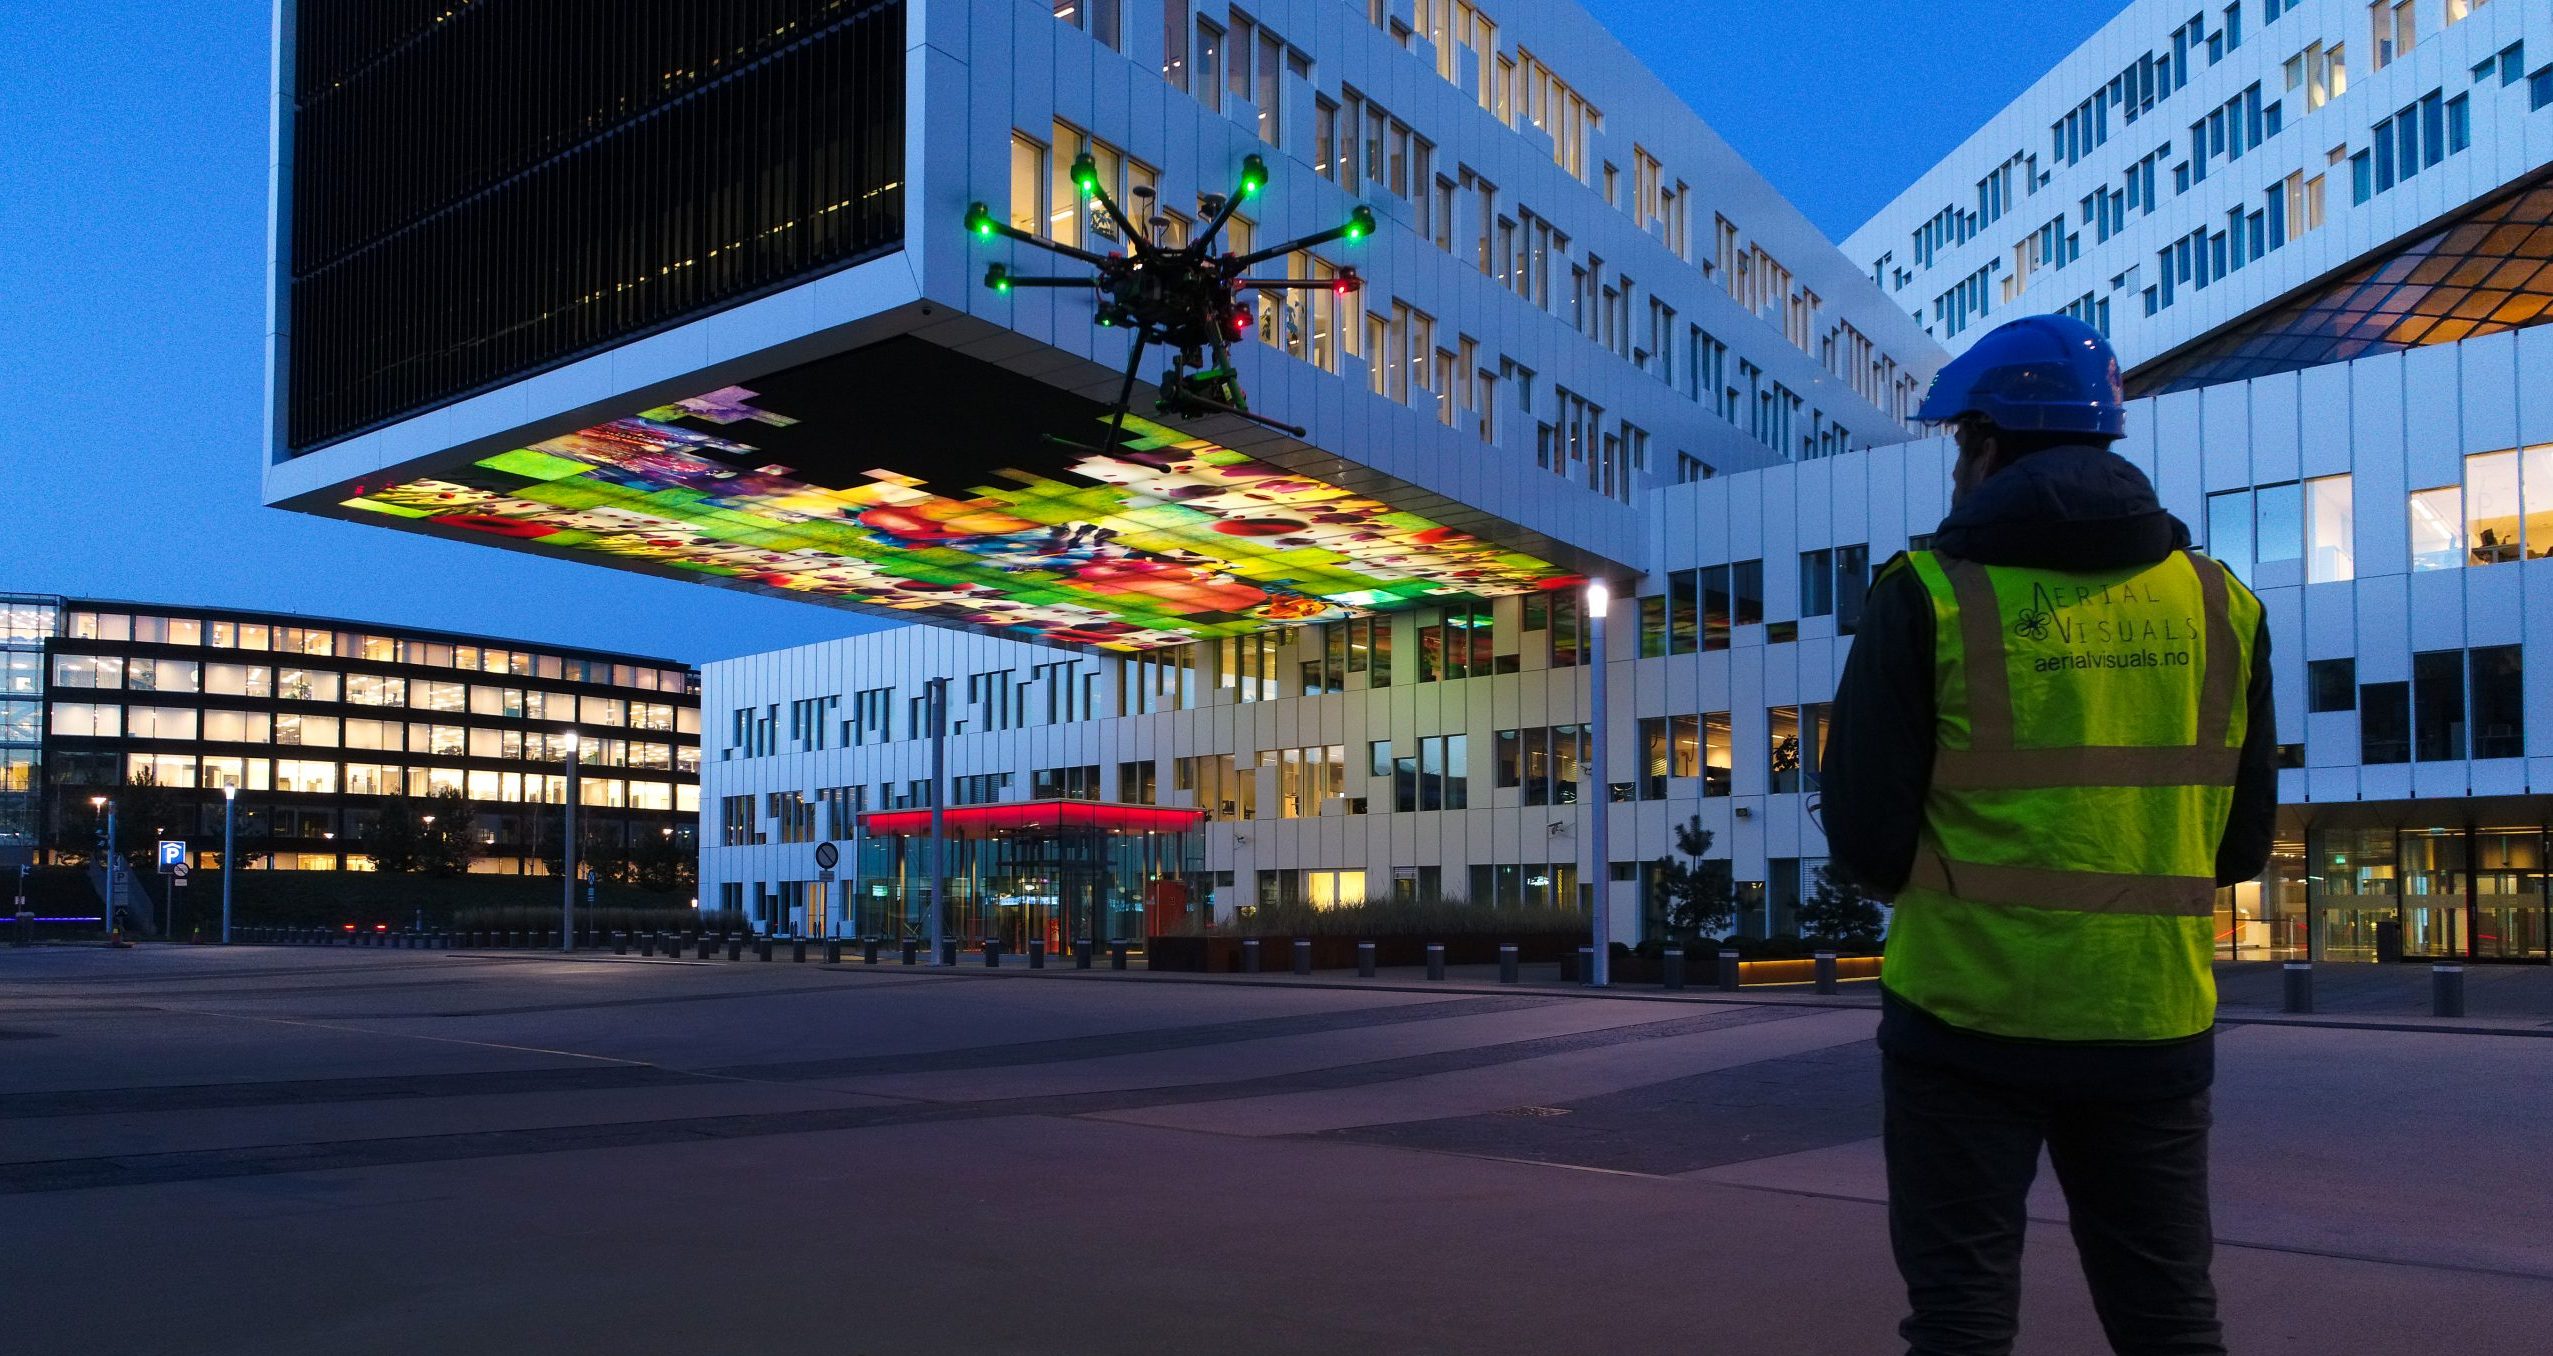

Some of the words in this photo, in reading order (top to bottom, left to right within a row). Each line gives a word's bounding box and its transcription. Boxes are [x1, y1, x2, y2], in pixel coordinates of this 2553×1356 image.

[2033, 582, 2160, 613] AERIAL
[2051, 610, 2198, 644] VISUALS
[2035, 648, 2190, 672] aerialvisuals.no
[166, 847, 179, 864] P
